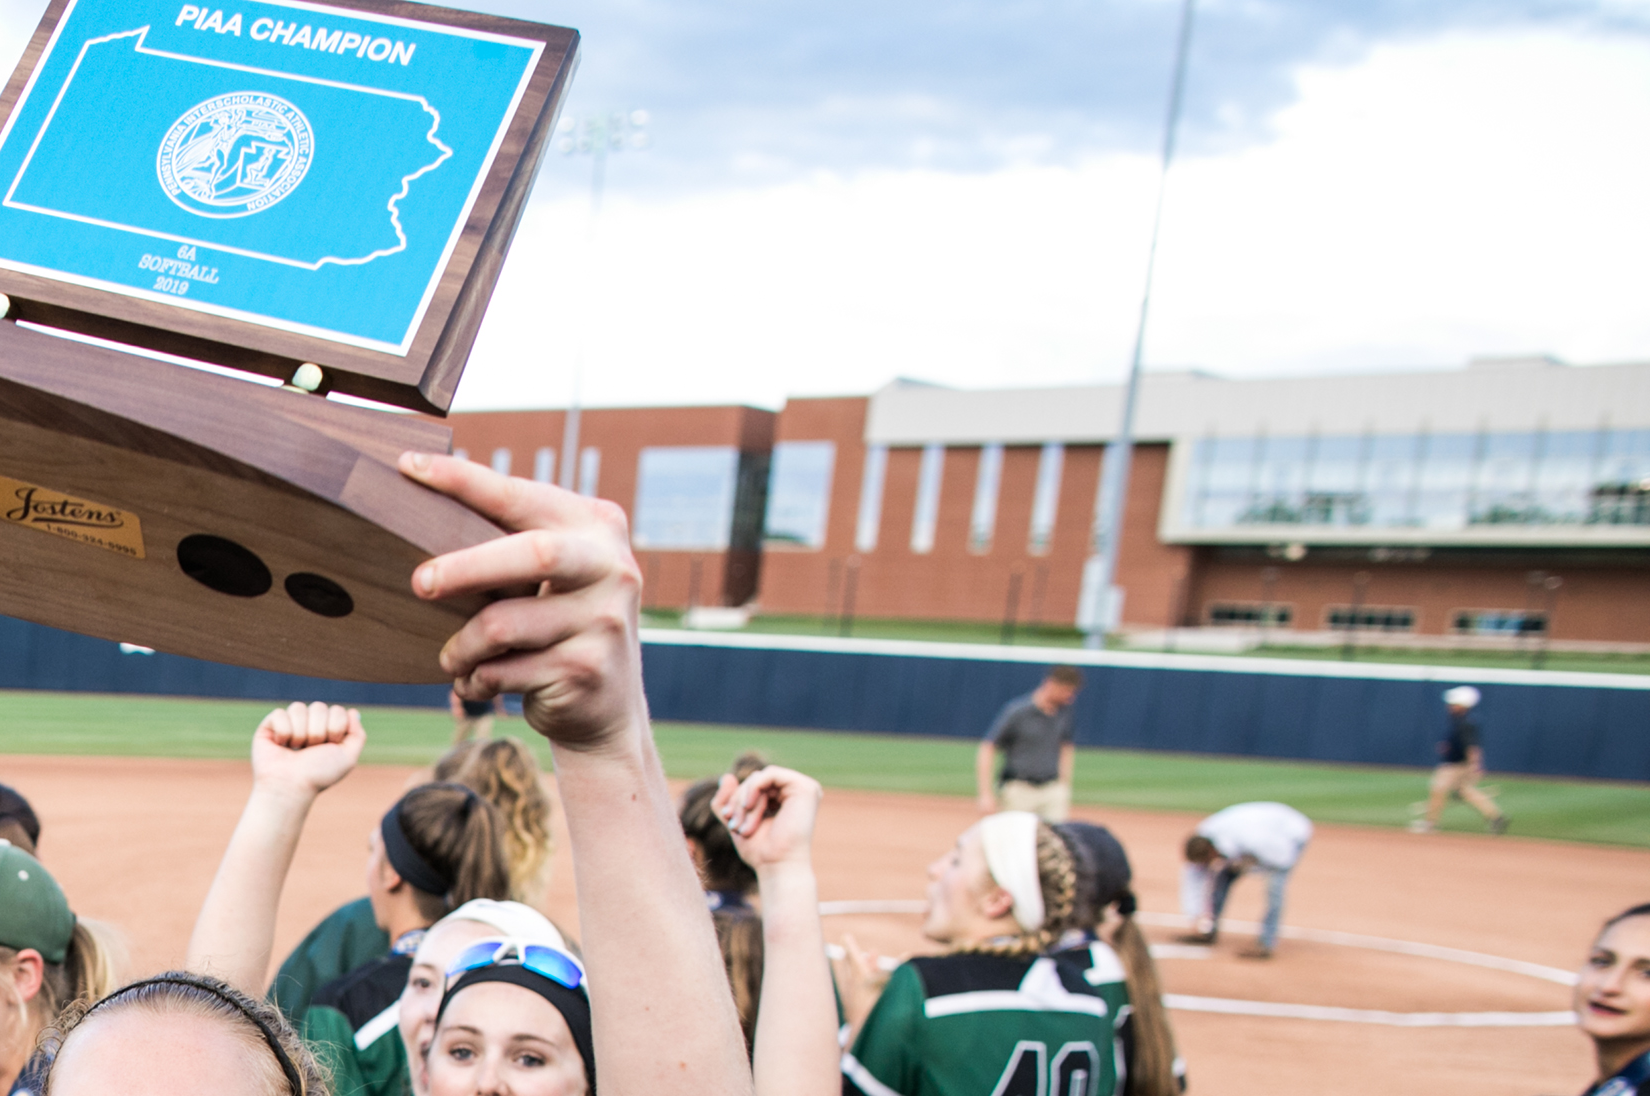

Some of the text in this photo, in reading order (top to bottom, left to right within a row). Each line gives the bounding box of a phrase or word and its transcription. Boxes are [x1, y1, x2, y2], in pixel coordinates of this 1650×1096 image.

[175, 4, 416, 66] PIAA CHAMPION
[161, 95, 310, 211] PENNSYLVANIA INTERSCHOLASTIC ATHLETIC ASSOCIATION
[138, 253, 219, 284] SOFTBALL
[177, 244, 196, 261] 6A
[153, 275, 189, 295] 2019
[6, 487, 120, 524] Jostens
